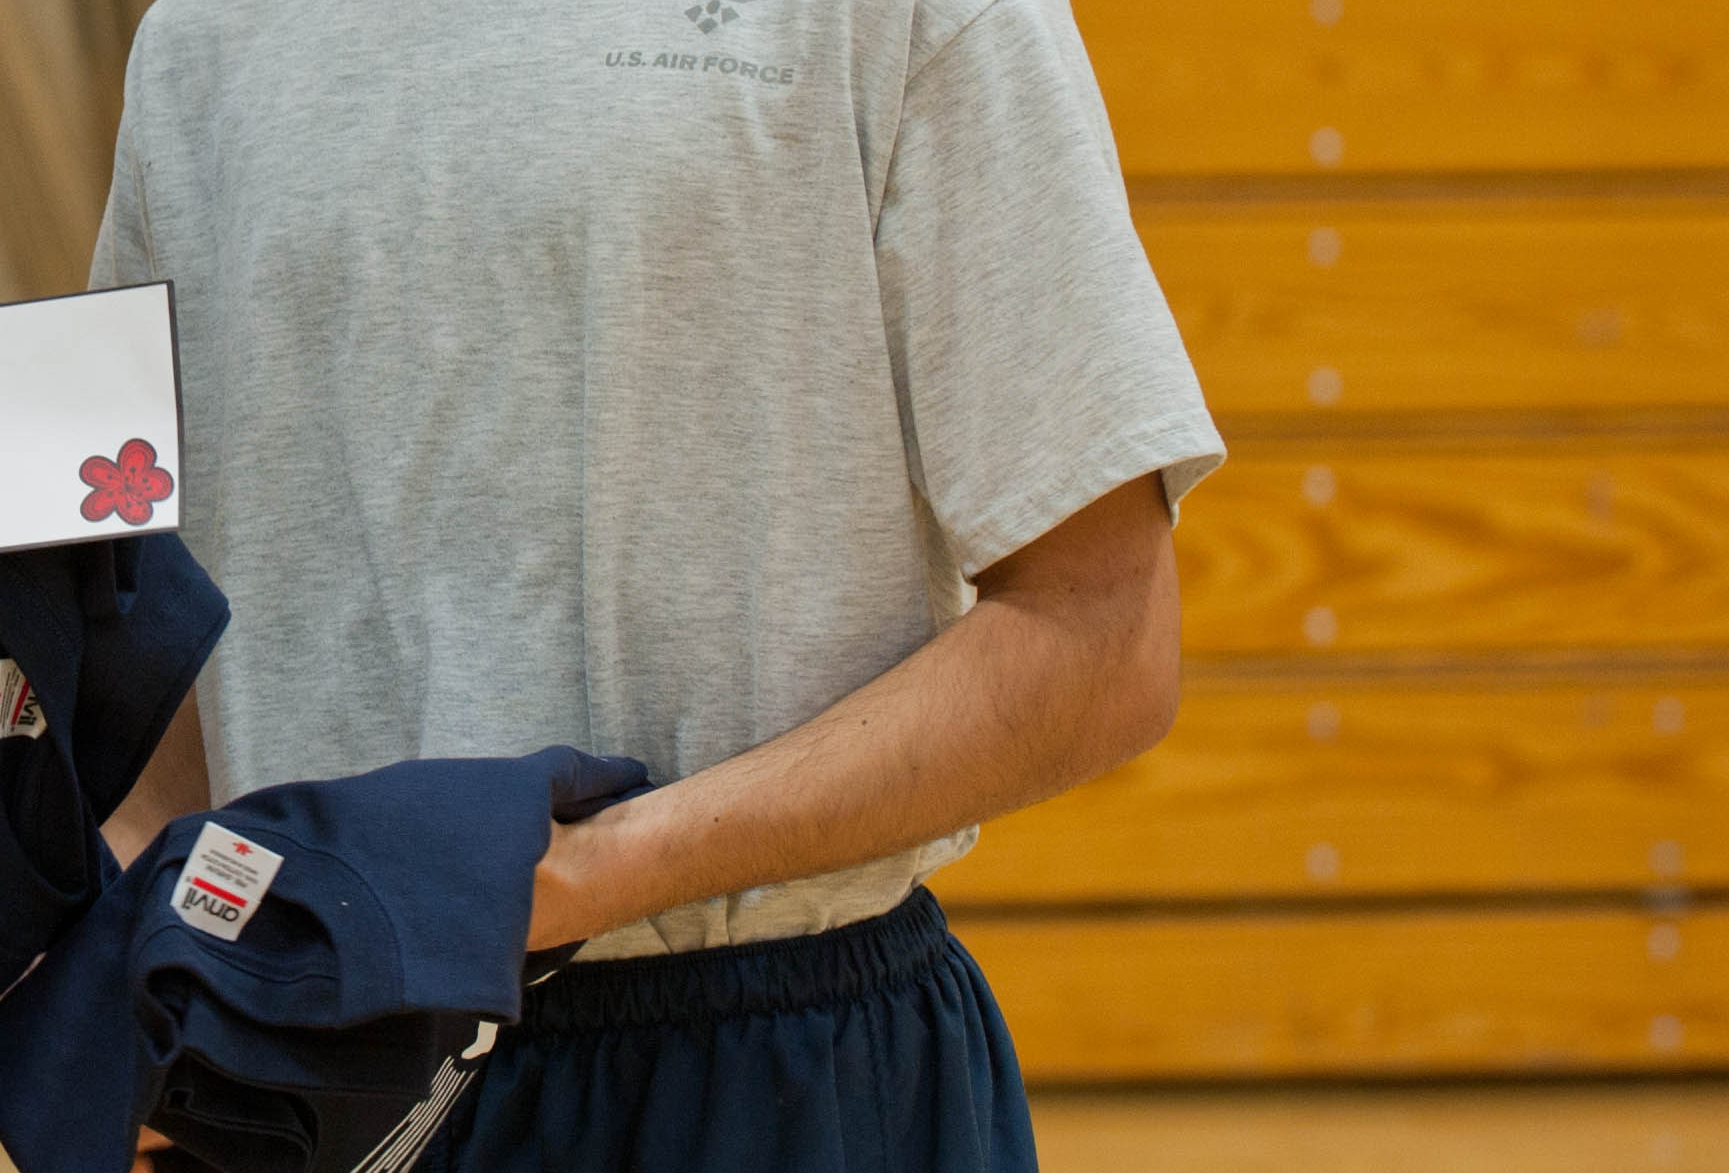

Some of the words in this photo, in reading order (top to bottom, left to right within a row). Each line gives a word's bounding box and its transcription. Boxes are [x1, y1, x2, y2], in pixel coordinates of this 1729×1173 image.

[604, 50, 647, 68] U.S.
[652, 51, 698, 71] AIR
[701, 54, 795, 85] FORCE
[181, 887, 240, 922] anvil
